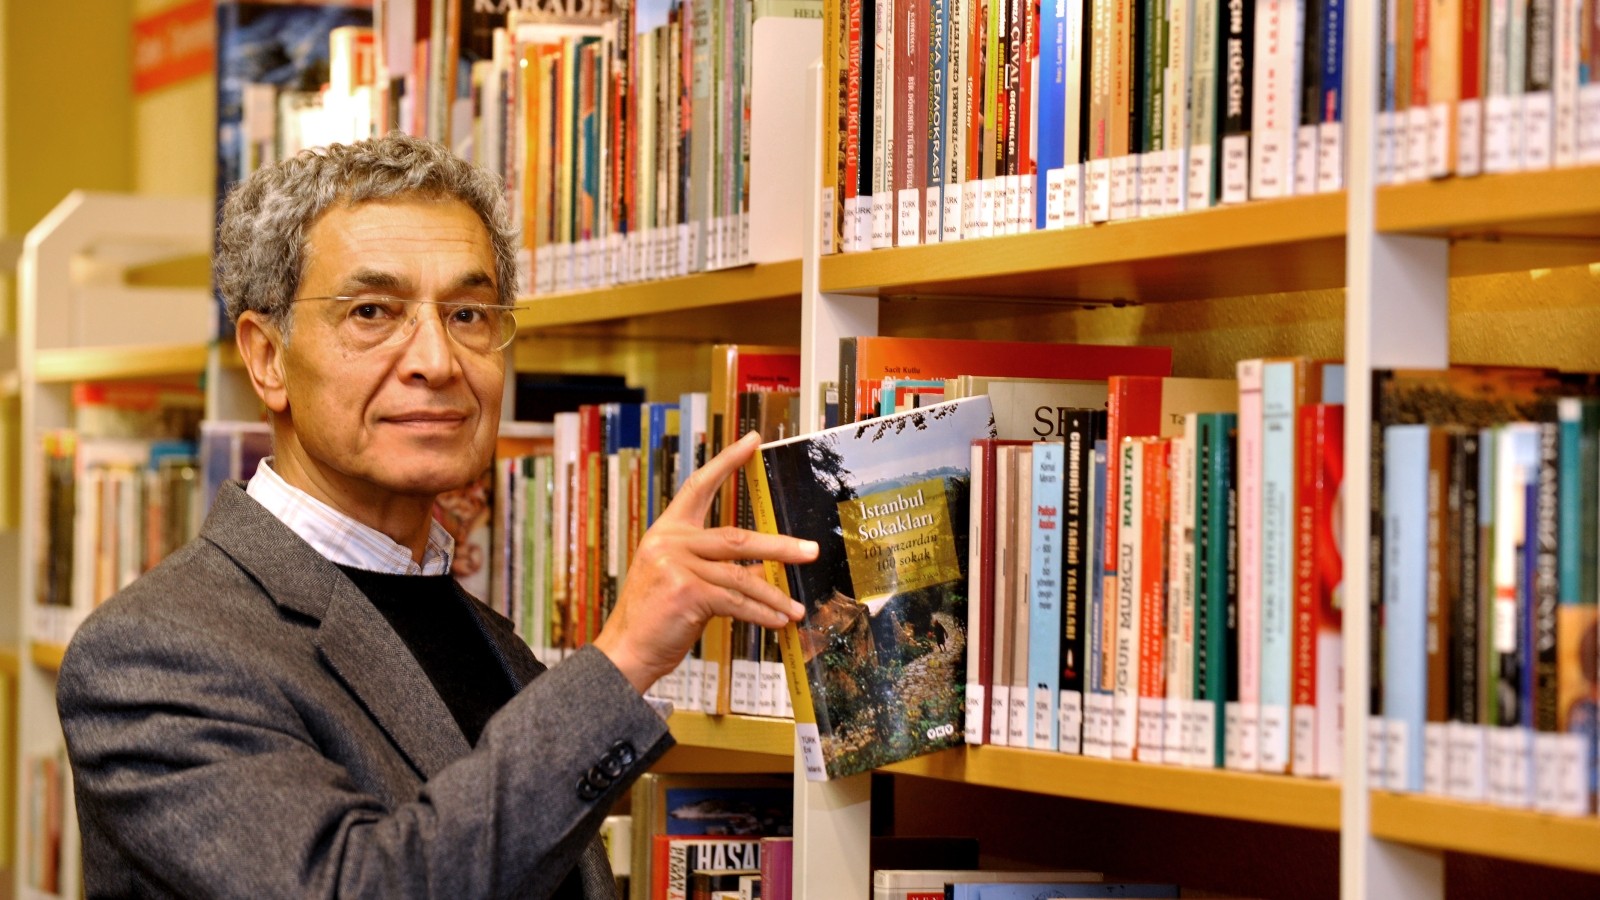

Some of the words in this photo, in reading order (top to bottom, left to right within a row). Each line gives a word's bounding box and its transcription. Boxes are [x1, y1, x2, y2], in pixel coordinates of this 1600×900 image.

[1010, 26, 1020, 88] ÇUVAL
[932, 70, 942, 182] DEMOKRASİ
[860, 488, 925, 520] İstanbul
[1068, 432, 1080, 515] CUMHURİYET
[1123, 446, 1132, 528] RABITA
[858, 512, 934, 542] Sokakları
[864, 545, 882, 559] 101
[887, 533, 938, 557] yazardan
[1067, 520, 1080, 564] TARİHİ
[876, 557, 896, 572] 100
[900, 548, 931, 566] sokak
[1120, 543, 1132, 630] MUMCU
[1066, 568, 1078, 640] YALANLARI
